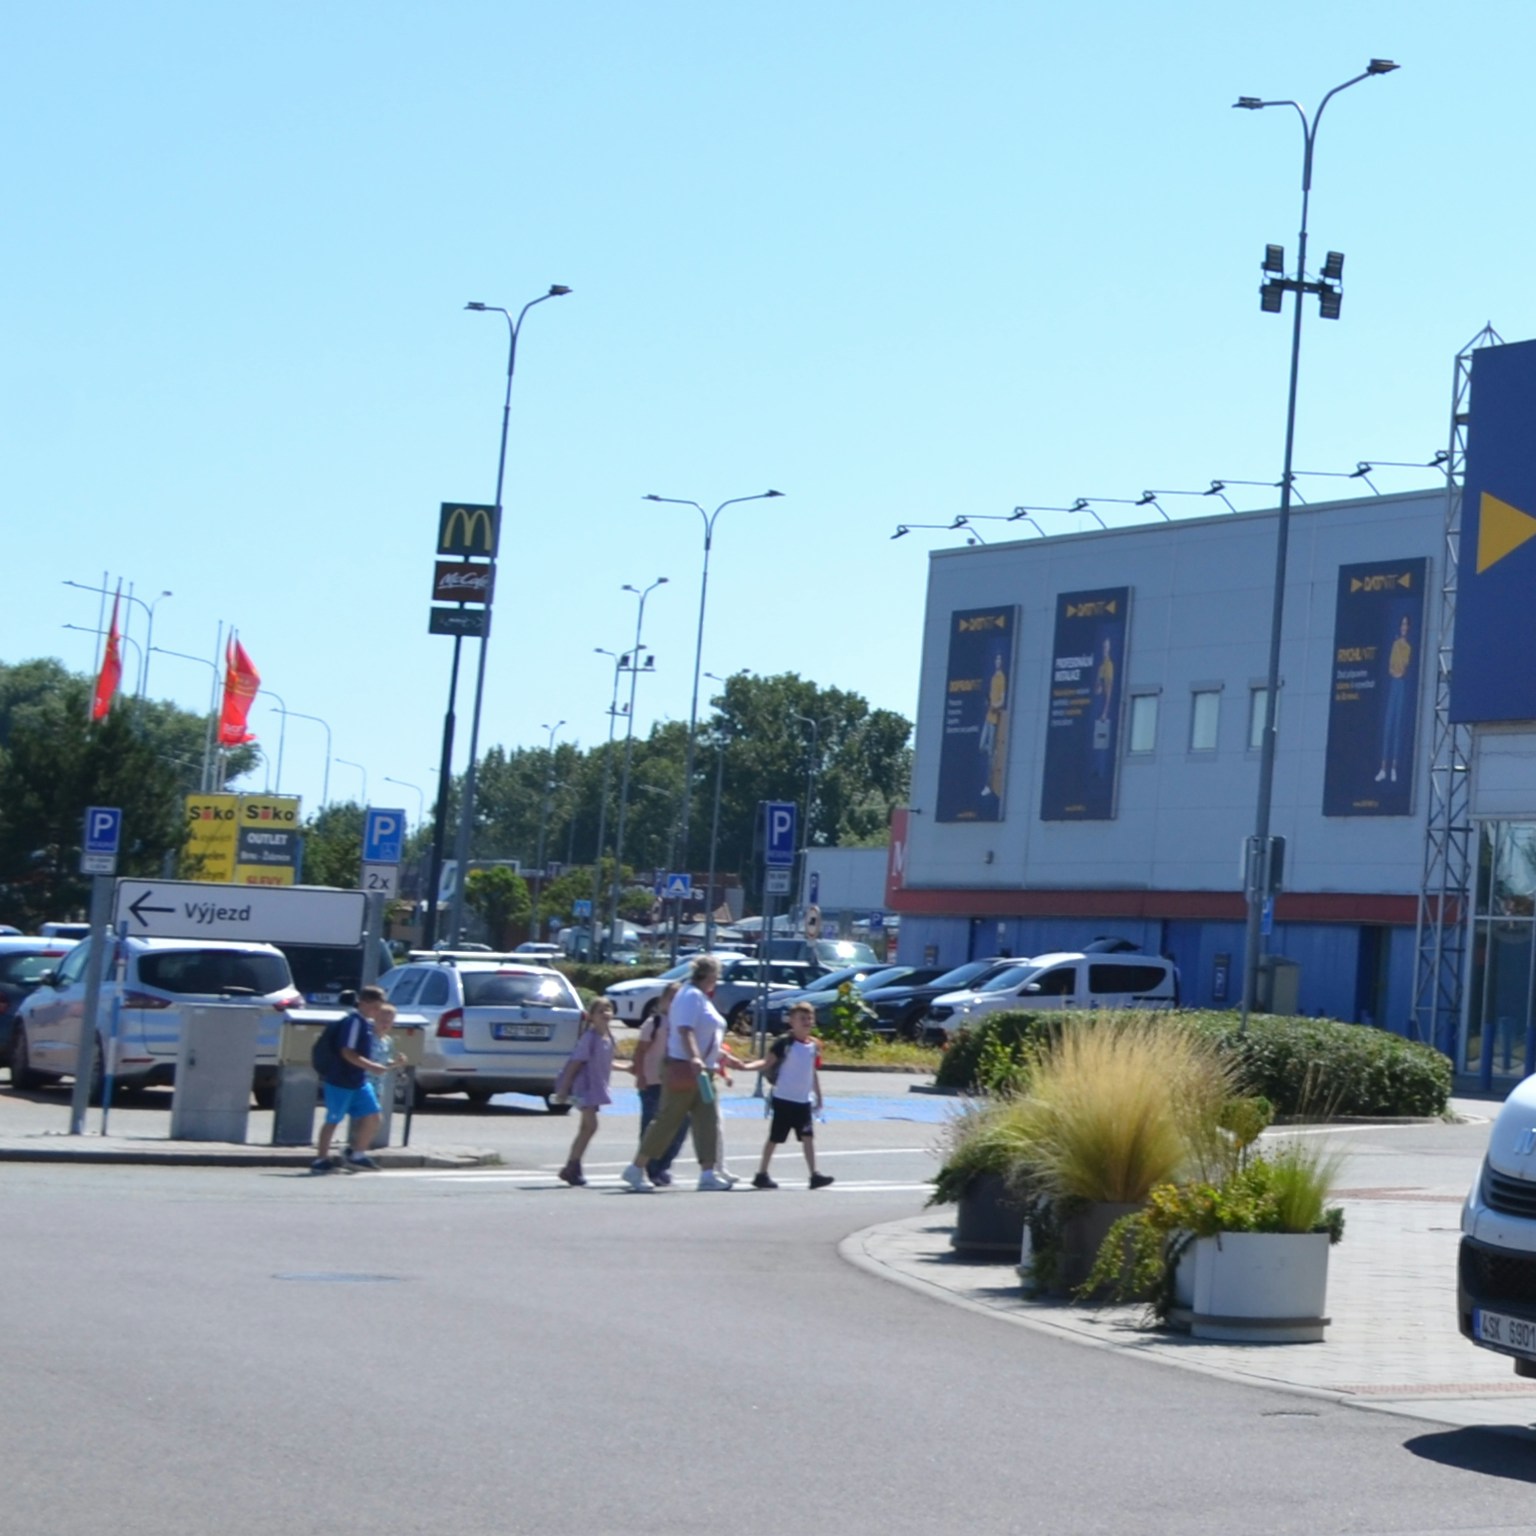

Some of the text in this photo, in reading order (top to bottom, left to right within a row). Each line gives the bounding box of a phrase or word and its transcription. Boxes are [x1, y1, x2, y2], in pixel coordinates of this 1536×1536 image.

[94, 813, 114, 839] P
[372, 816, 396, 846] P
[773, 810, 791, 846] P
[247, 833, 288, 846] OUTLET
[368, 872, 390, 890] 2x
[184, 903, 251, 925] Výjezd
